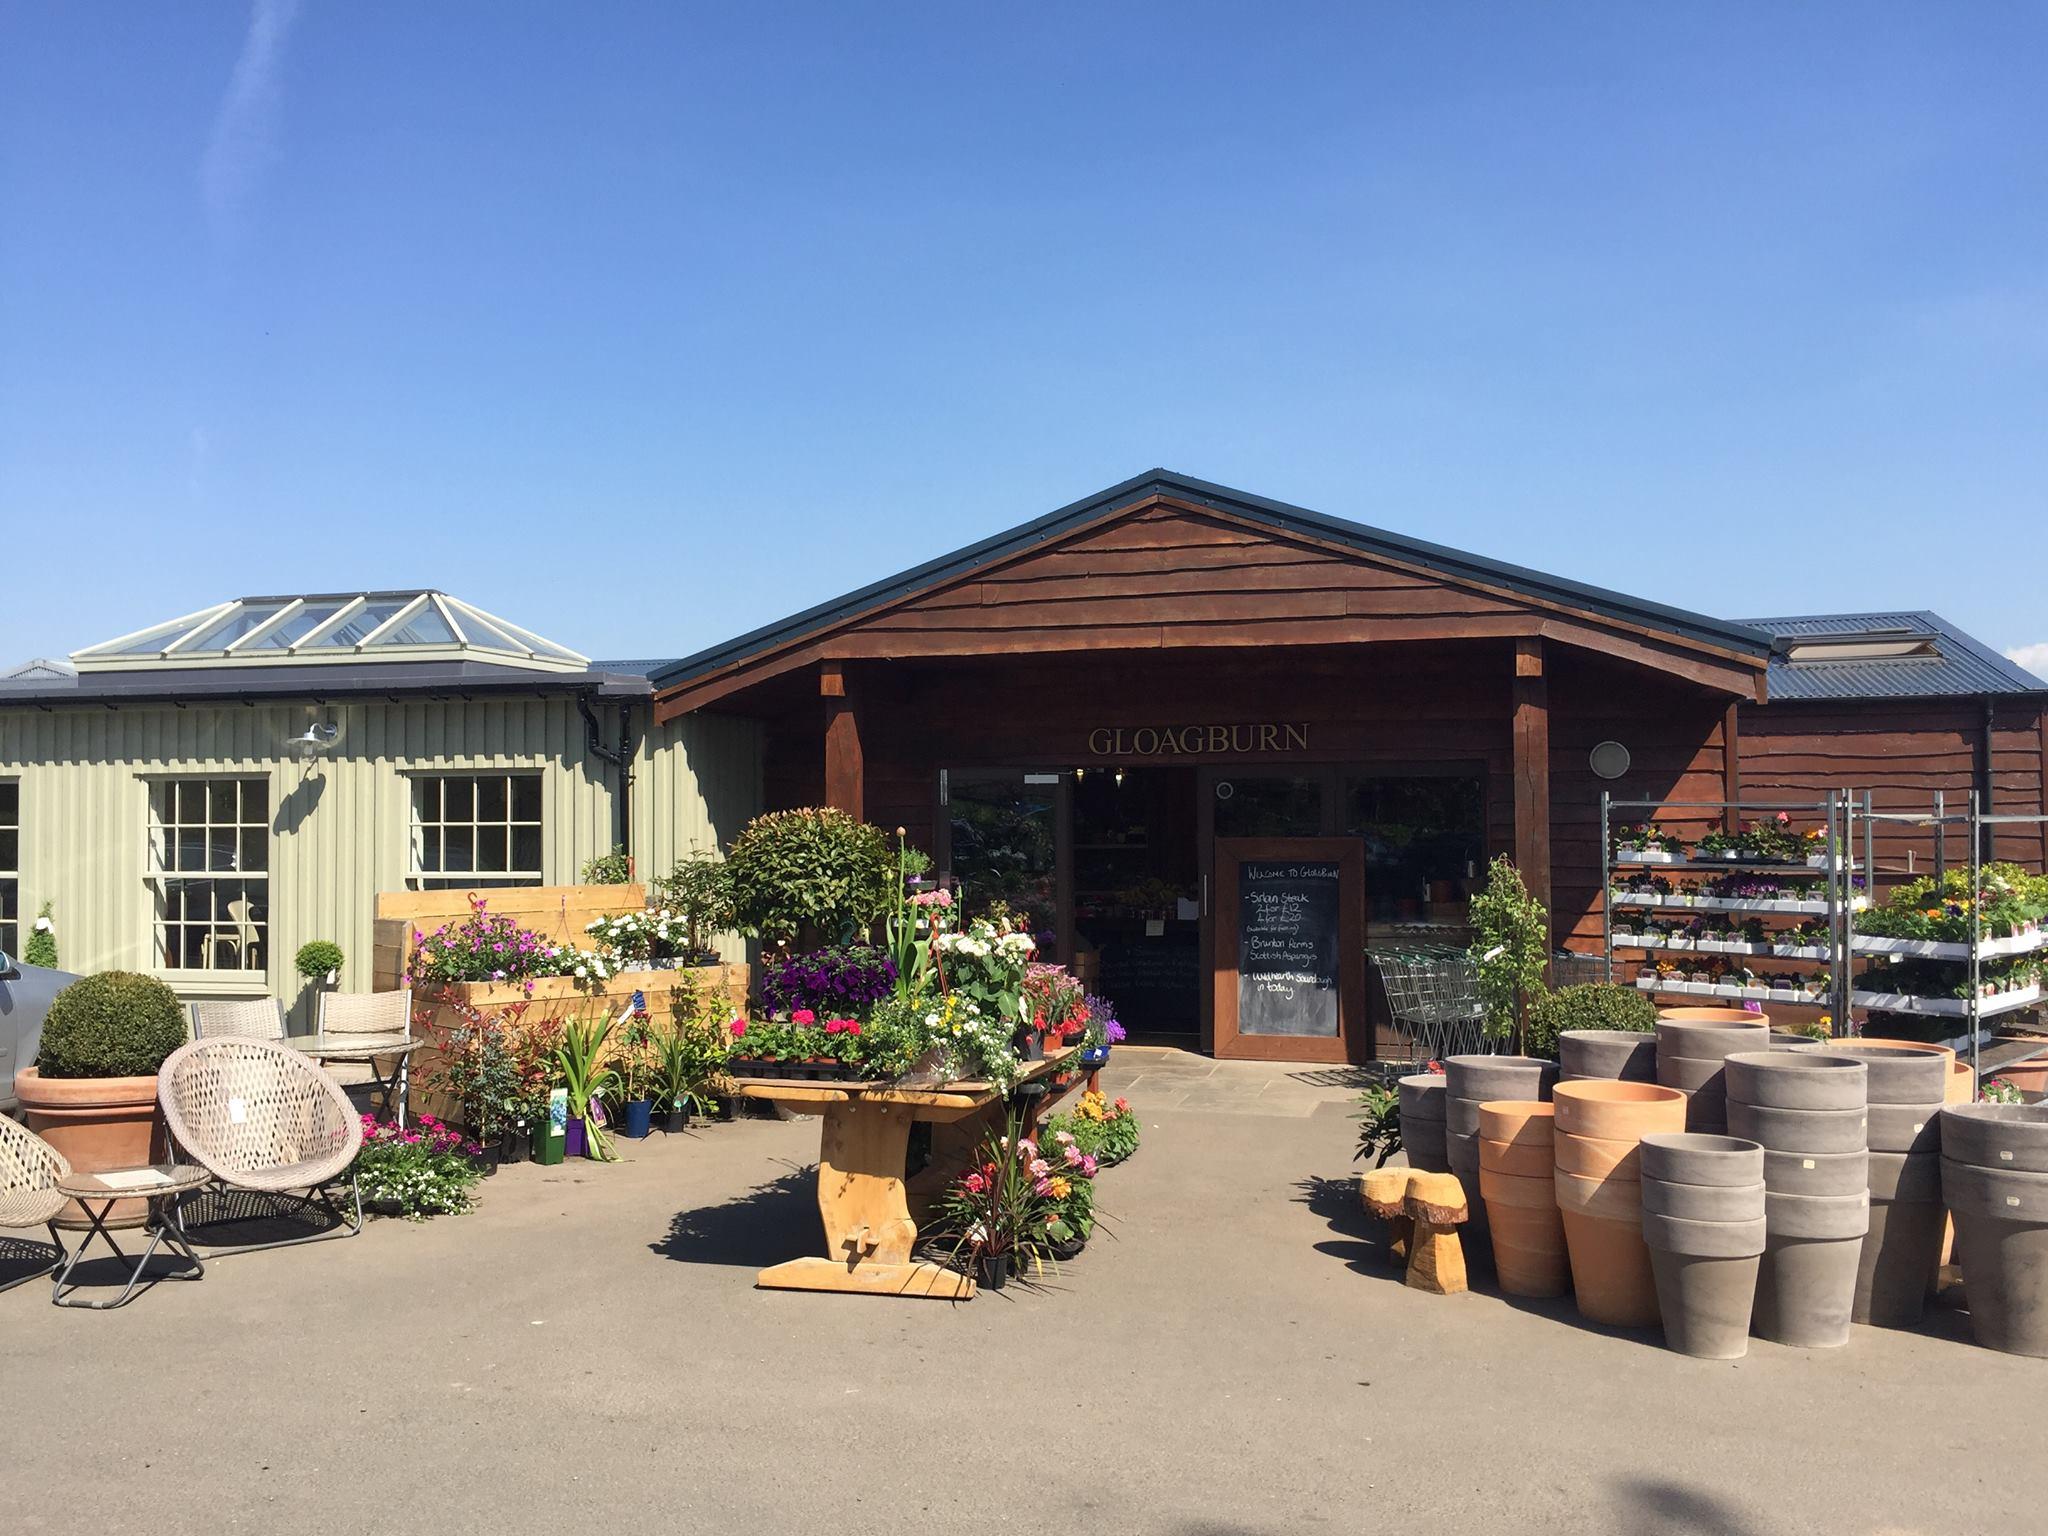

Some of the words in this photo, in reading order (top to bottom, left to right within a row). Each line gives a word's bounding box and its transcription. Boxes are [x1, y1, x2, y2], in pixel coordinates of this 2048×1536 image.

[1088, 723, 1311, 755] GLOAGBURN
[1281, 892, 1309, 904] Steak
[1256, 903, 1265, 913] 2
[1265, 903, 1280, 914] for
[1281, 903, 1302, 914] £12
[1250, 950, 1282, 960] Scottish
[1256, 983, 1265, 992] in
[1267, 981, 1294, 1001] today
